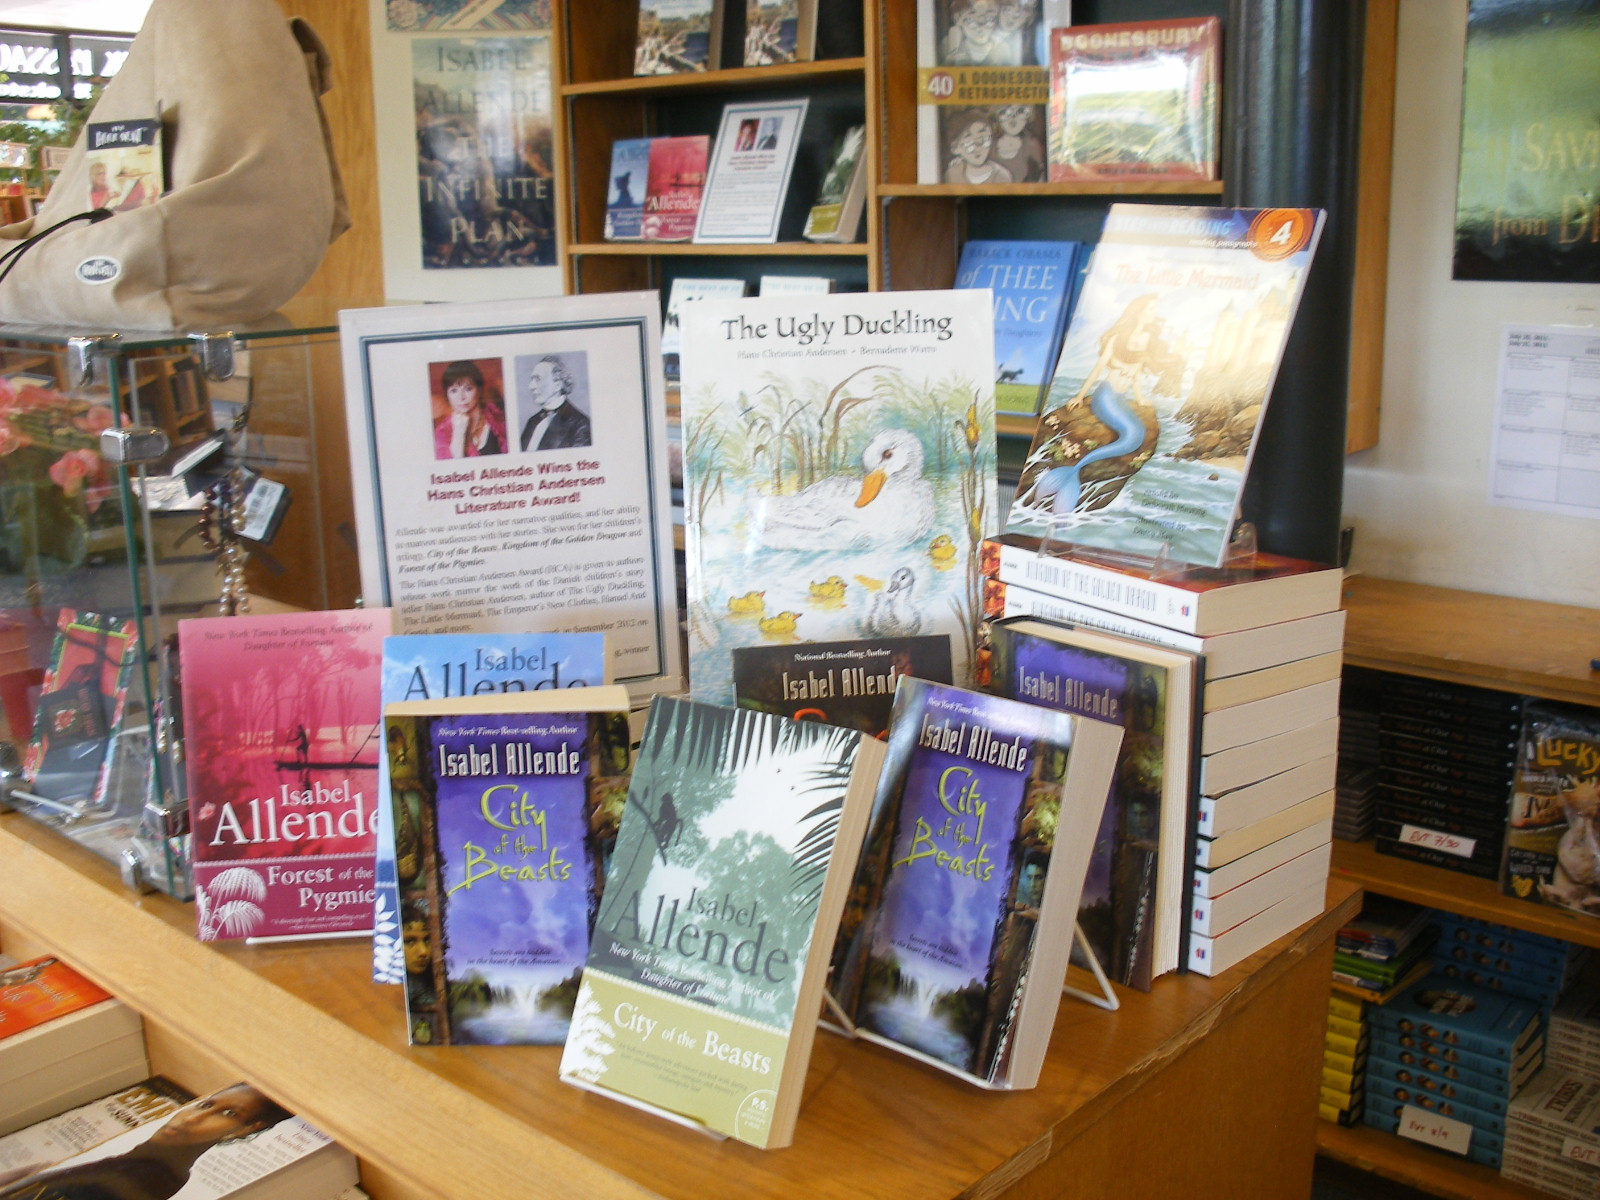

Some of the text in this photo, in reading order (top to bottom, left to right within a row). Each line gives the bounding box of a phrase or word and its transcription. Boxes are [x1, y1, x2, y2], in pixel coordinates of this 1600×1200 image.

[1060, 28, 1206, 51] DOONESBURY
[438, 46, 528, 72] ISABEL
[928, 76, 954, 97] 40
[423, 177, 548, 202] INFINITE
[451, 216, 524, 243] PLAN
[1270, 220, 1294, 245] 4
[1491, 206, 1549, 246] from
[961, 264, 1058, 290] of THEE
[993, 296, 1049, 324] ING
[721, 309, 953, 345] The Ugly Duckling
[431, 459, 600, 485] Isabel Allende Wins the
[427, 475, 606, 502] Hans Christian Andersen
[455, 499, 526, 515] Literature
[398, 564, 425, 575] Forest
[475, 646, 548, 672] Isabel
[782, 664, 897, 701] Isabel Allend
[1019, 665, 1118, 719] Isabel Allende
[438, 727, 457, 737] New
[458, 727, 476, 737] York
[476, 726, 500, 737] Times
[547, 724, 578, 735] Author
[918, 712, 967, 756] Isabel
[966, 724, 1028, 773] Allende
[438, 741, 580, 777] Isabel Allende
[280, 779, 350, 807] Isabel
[938, 765, 988, 845] City
[480, 784, 547, 851] City
[493, 833, 538, 861] of the
[936, 817, 973, 849] of the
[892, 816, 995, 882] Beasts
[267, 865, 374, 887] Forest of the
[446, 840, 572, 897] Beasts
[298, 883, 377, 912] Pygmie
[686, 887, 758, 928] Isabel
[610, 889, 790, 984] Allende
[609, 941, 630, 957] New
[631, 948, 652, 966] York
[653, 954, 678, 973] Times
[640, 966, 682, 990] Daughter
[683, 979, 698, 996] of
[613, 1001, 659, 1042] City
[661, 1026, 677, 1041] of
[677, 1030, 697, 1049] the
[701, 1029, 772, 1075] Beasts
